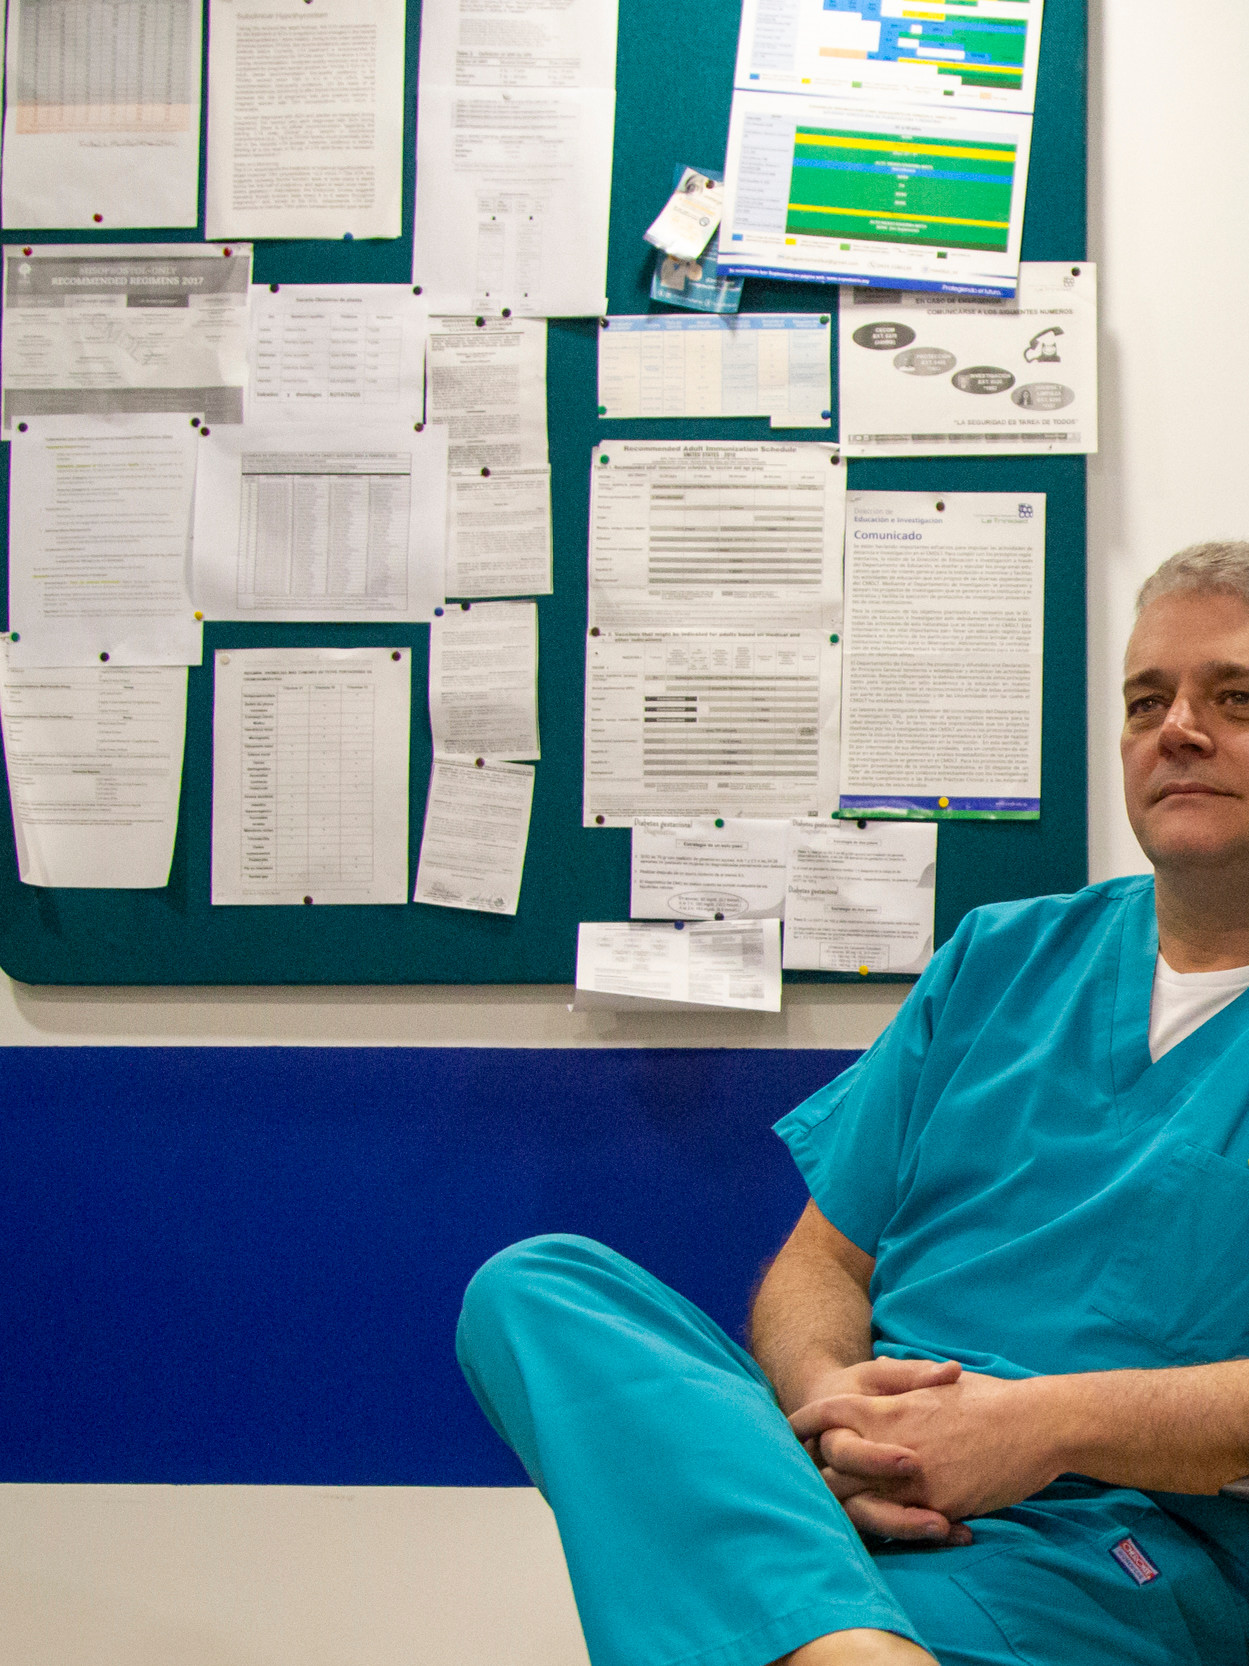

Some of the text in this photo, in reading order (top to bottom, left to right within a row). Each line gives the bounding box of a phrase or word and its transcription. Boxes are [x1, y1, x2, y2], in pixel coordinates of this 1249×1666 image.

[51, 276, 204, 286] RECOMMENDED REGIMENS 2017
[942, 284, 978, 294] Protegiendo
[897, 516, 944, 525] Investigación
[854, 530, 923, 540] Comunicado
[634, 818, 692, 829] Diabetes gestacional
[792, 819, 841, 830] Diabetes gestacional
[788, 885, 839, 896] Diabetes gestacional
